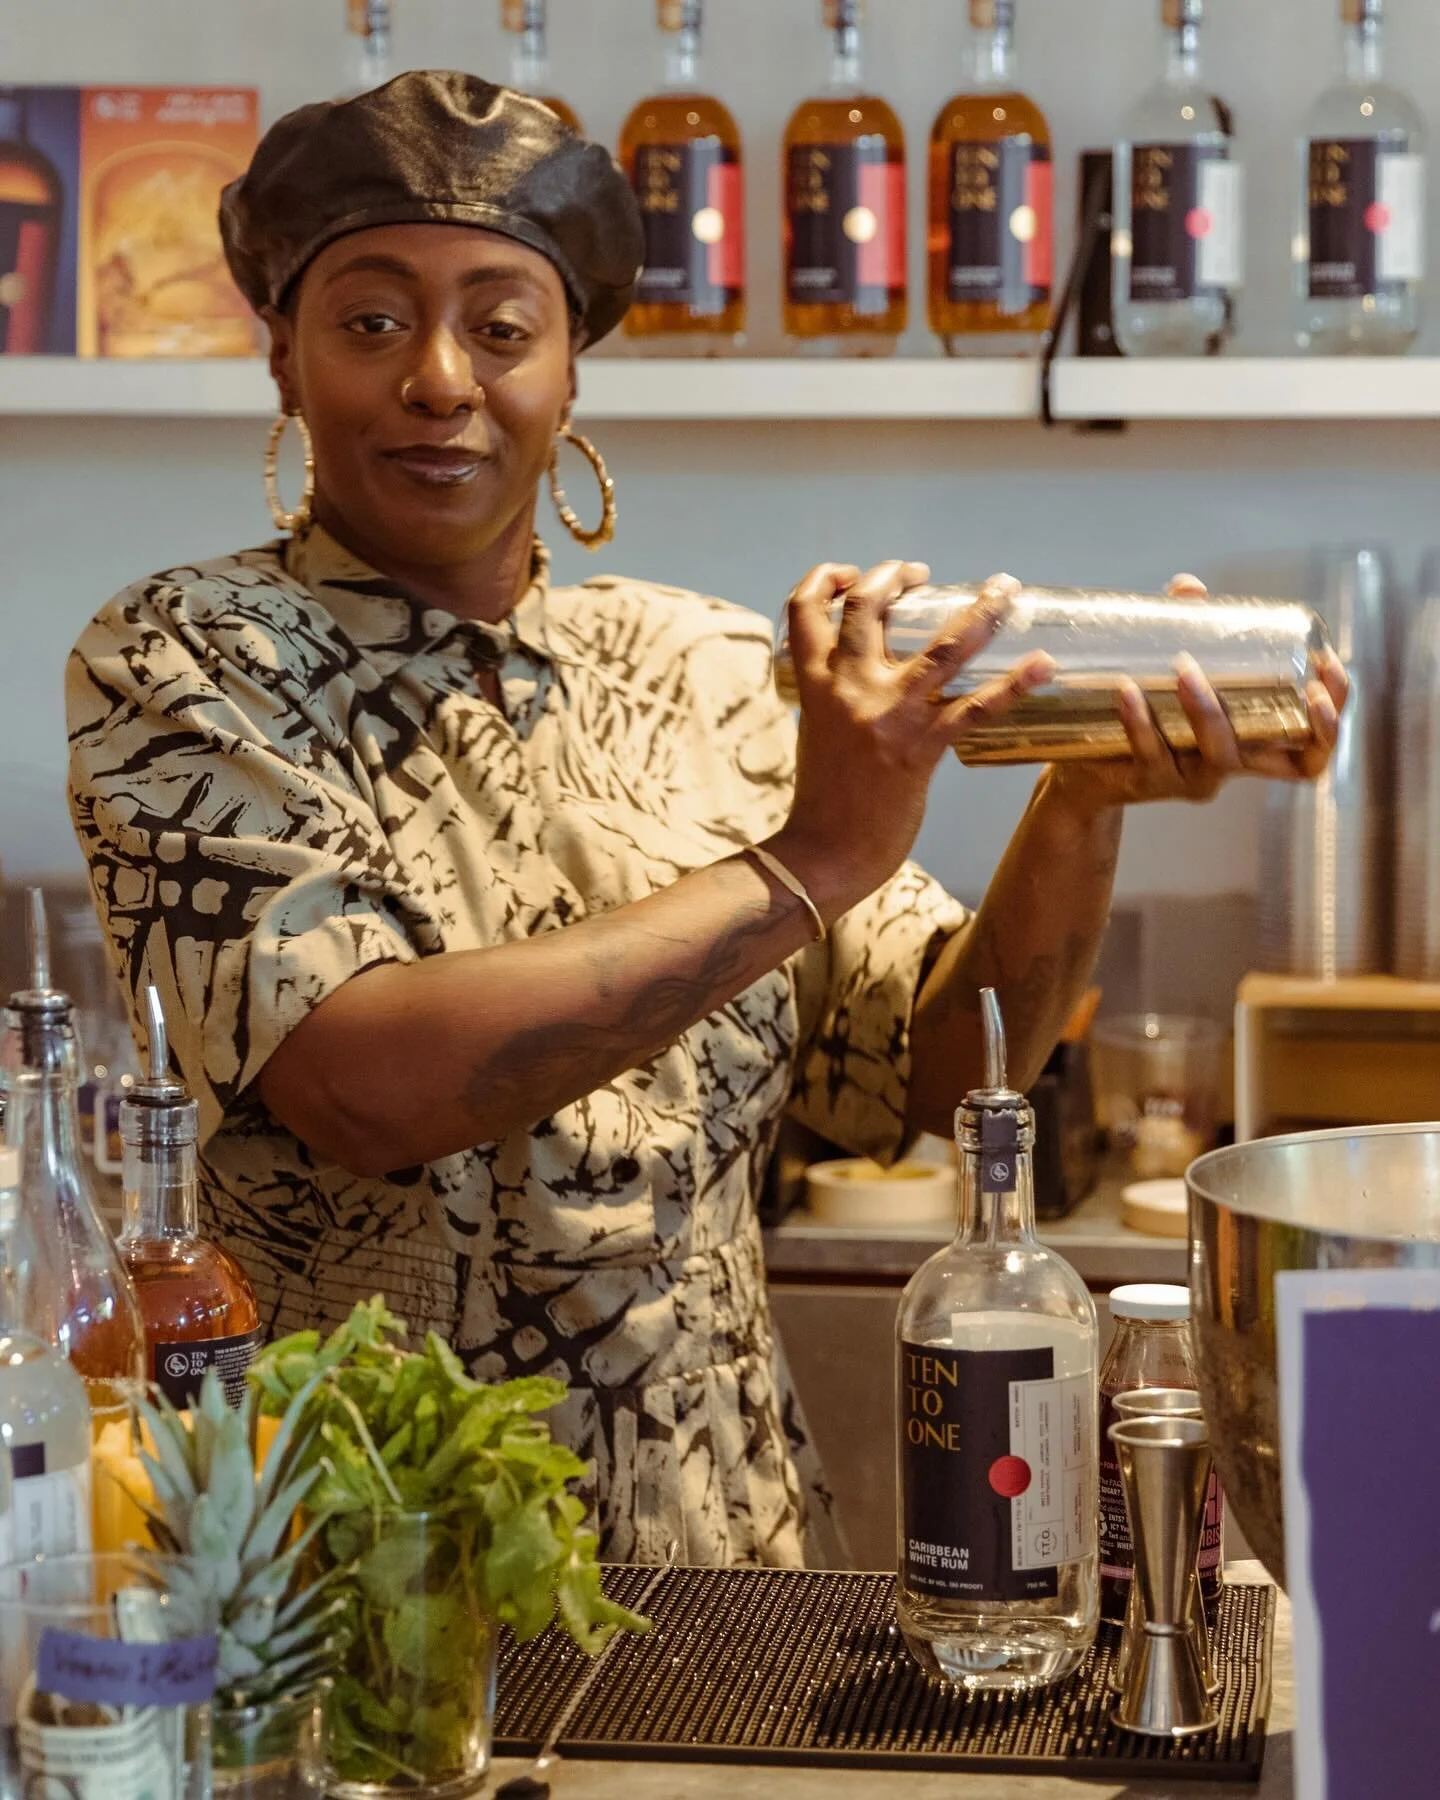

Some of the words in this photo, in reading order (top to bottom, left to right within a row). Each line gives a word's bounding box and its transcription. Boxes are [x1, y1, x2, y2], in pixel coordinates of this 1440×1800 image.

[191, 1351, 207, 1360] TEN
[191, 1359, 203, 1368] TO
[906, 1353, 958, 1387] TEN
[907, 1385, 943, 1416] TO
[907, 1418, 961, 1451] ONE
[909, 1538, 970, 1559] CARIBBEAN
[909, 1550, 938, 1568] WHITE
[941, 1557, 969, 1571] RUM
